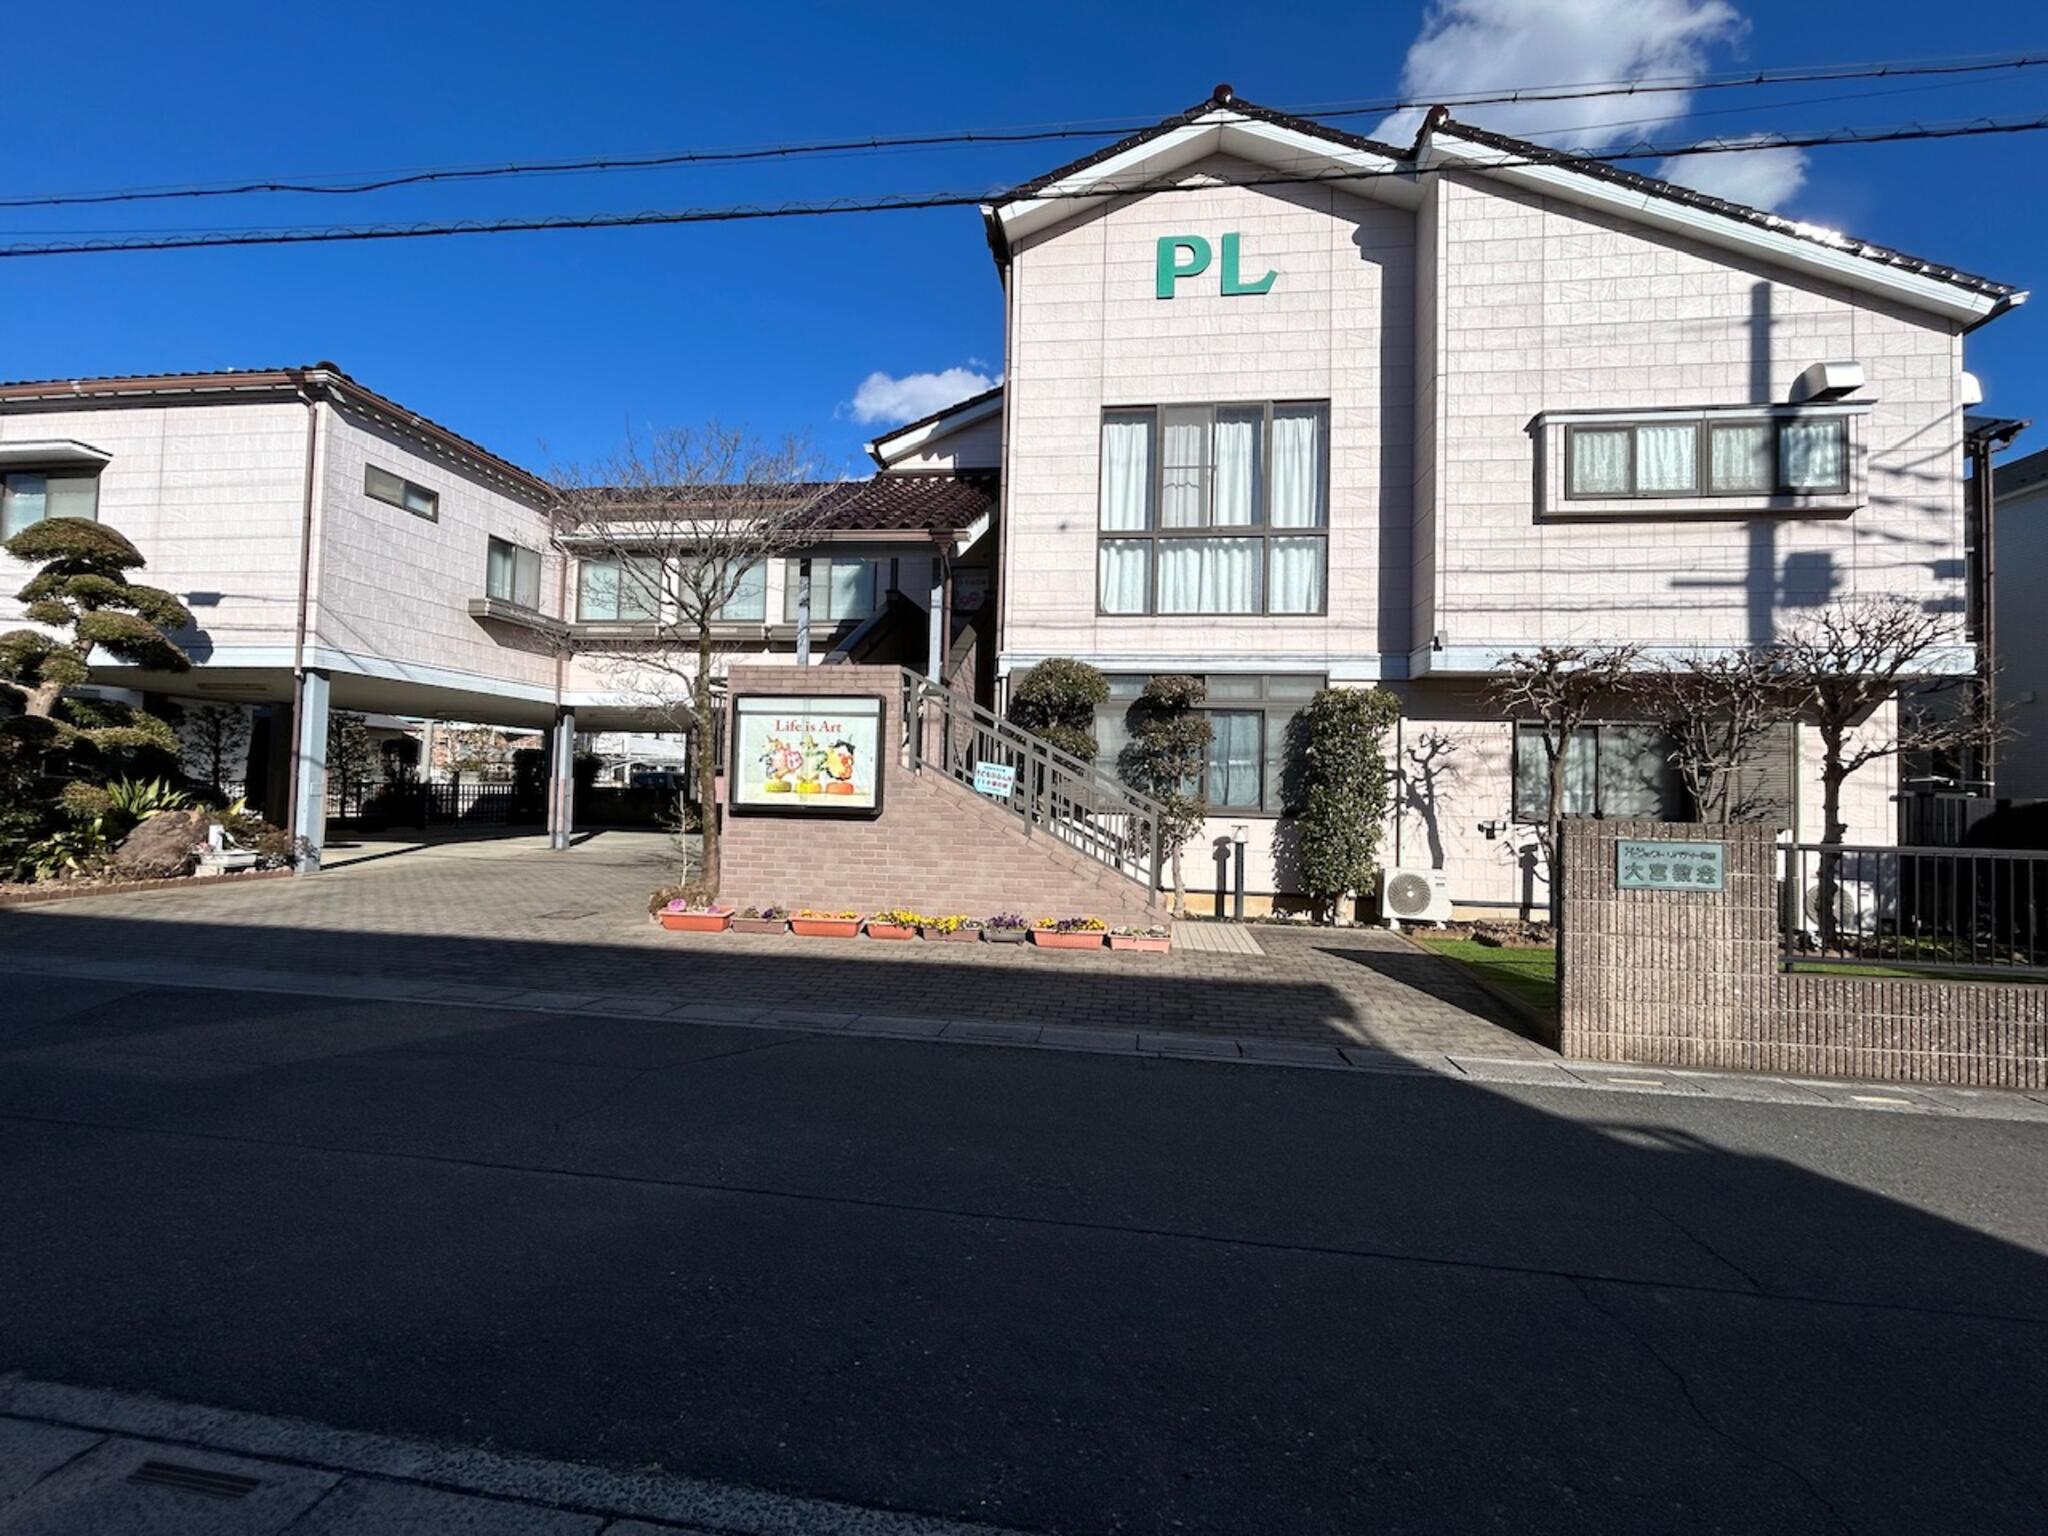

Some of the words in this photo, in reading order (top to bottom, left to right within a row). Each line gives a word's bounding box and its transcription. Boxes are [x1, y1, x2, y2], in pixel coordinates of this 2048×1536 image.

[1156, 232, 1278, 300] PL
[775, 719, 804, 733] Life
[805, 719, 816, 733] is
[818, 720, 842, 733] Art
[1624, 862, 1716, 884] 大宮教会
